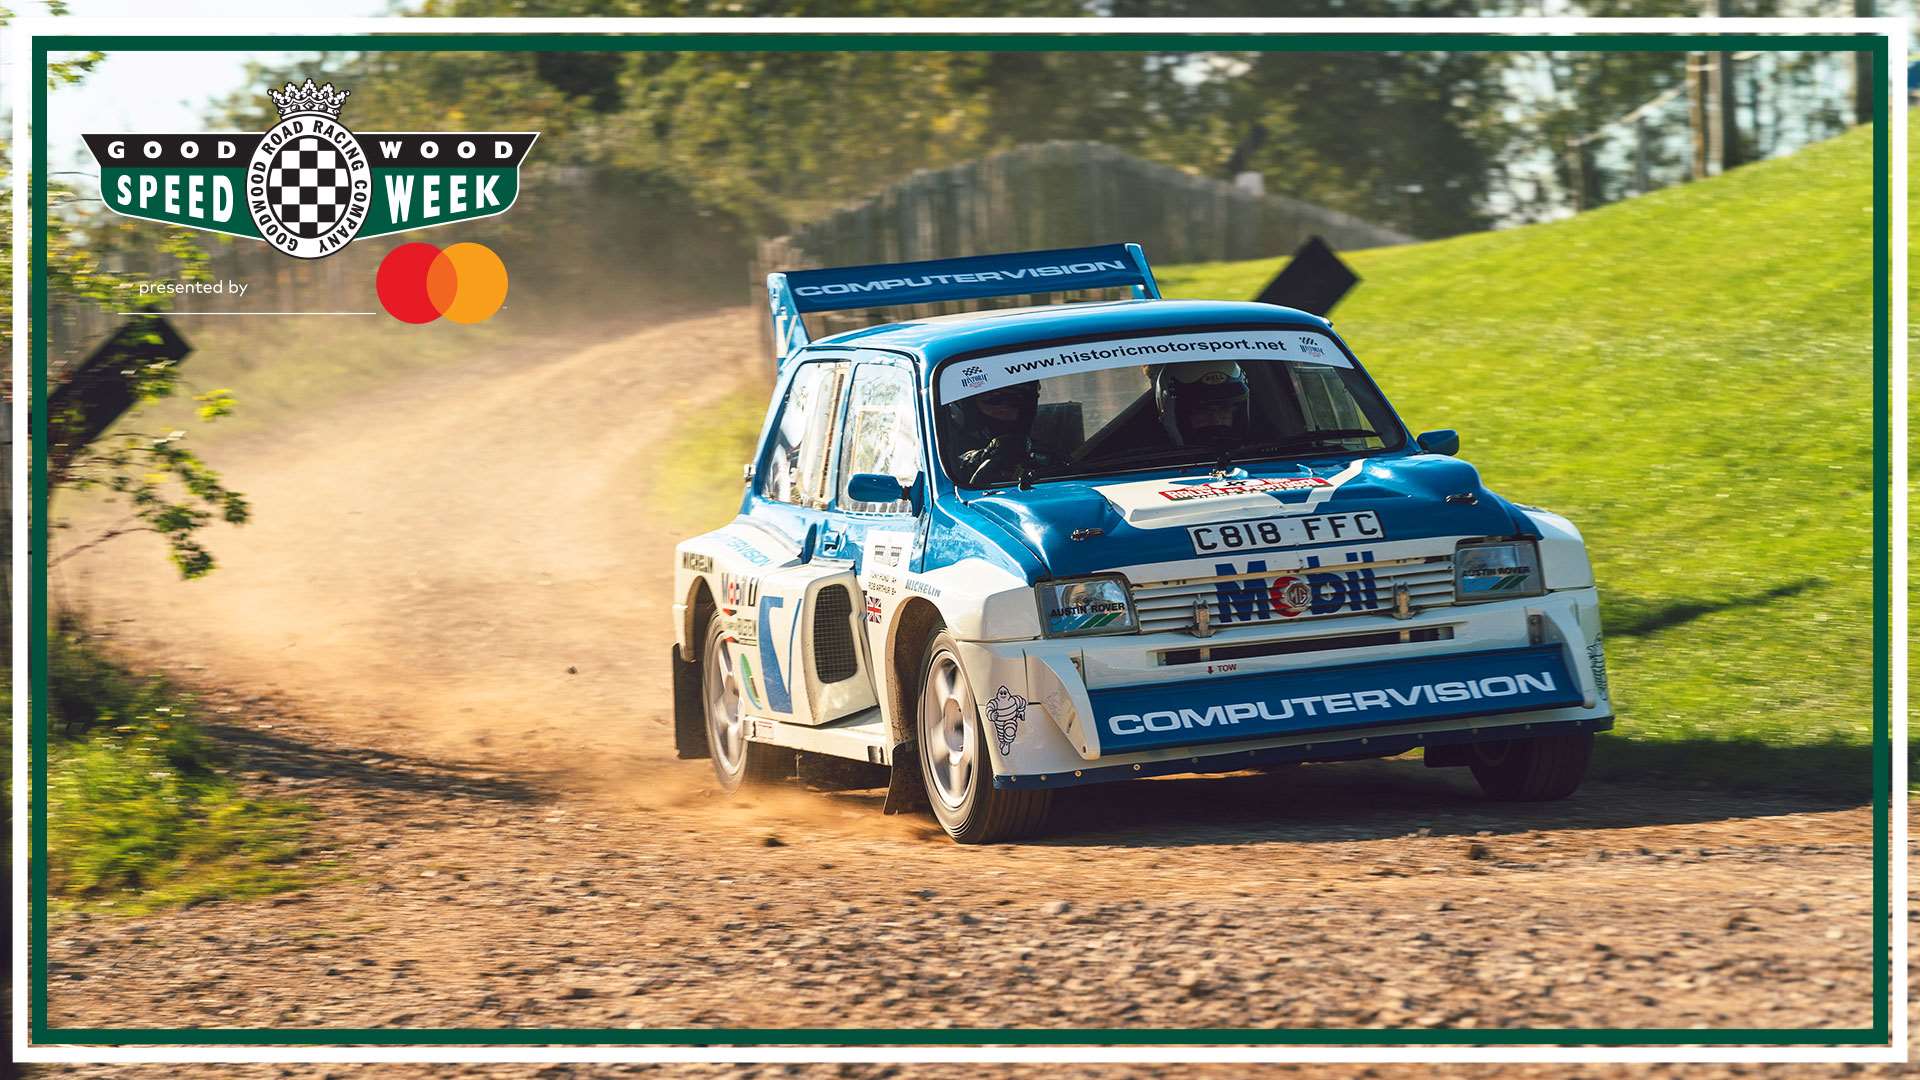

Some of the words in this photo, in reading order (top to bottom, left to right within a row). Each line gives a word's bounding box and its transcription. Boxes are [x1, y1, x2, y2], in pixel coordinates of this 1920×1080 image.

[794, 259, 1126, 298] COMPUTERVISION
[1004, 337, 1288, 376] www.historicmotorsport.net
[1193, 522, 1281, 551] C818
[1302, 513, 1377, 541] FFC
[905, 579, 942, 598] MICHELIN
[1214, 550, 1379, 623] Mobil
[1051, 604, 1088, 617] AUSTIN
[1090, 602, 1125, 613] ROVER
[1216, 663, 1237, 673] TOW
[1108, 671, 1558, 736] COMPUTERVISION
